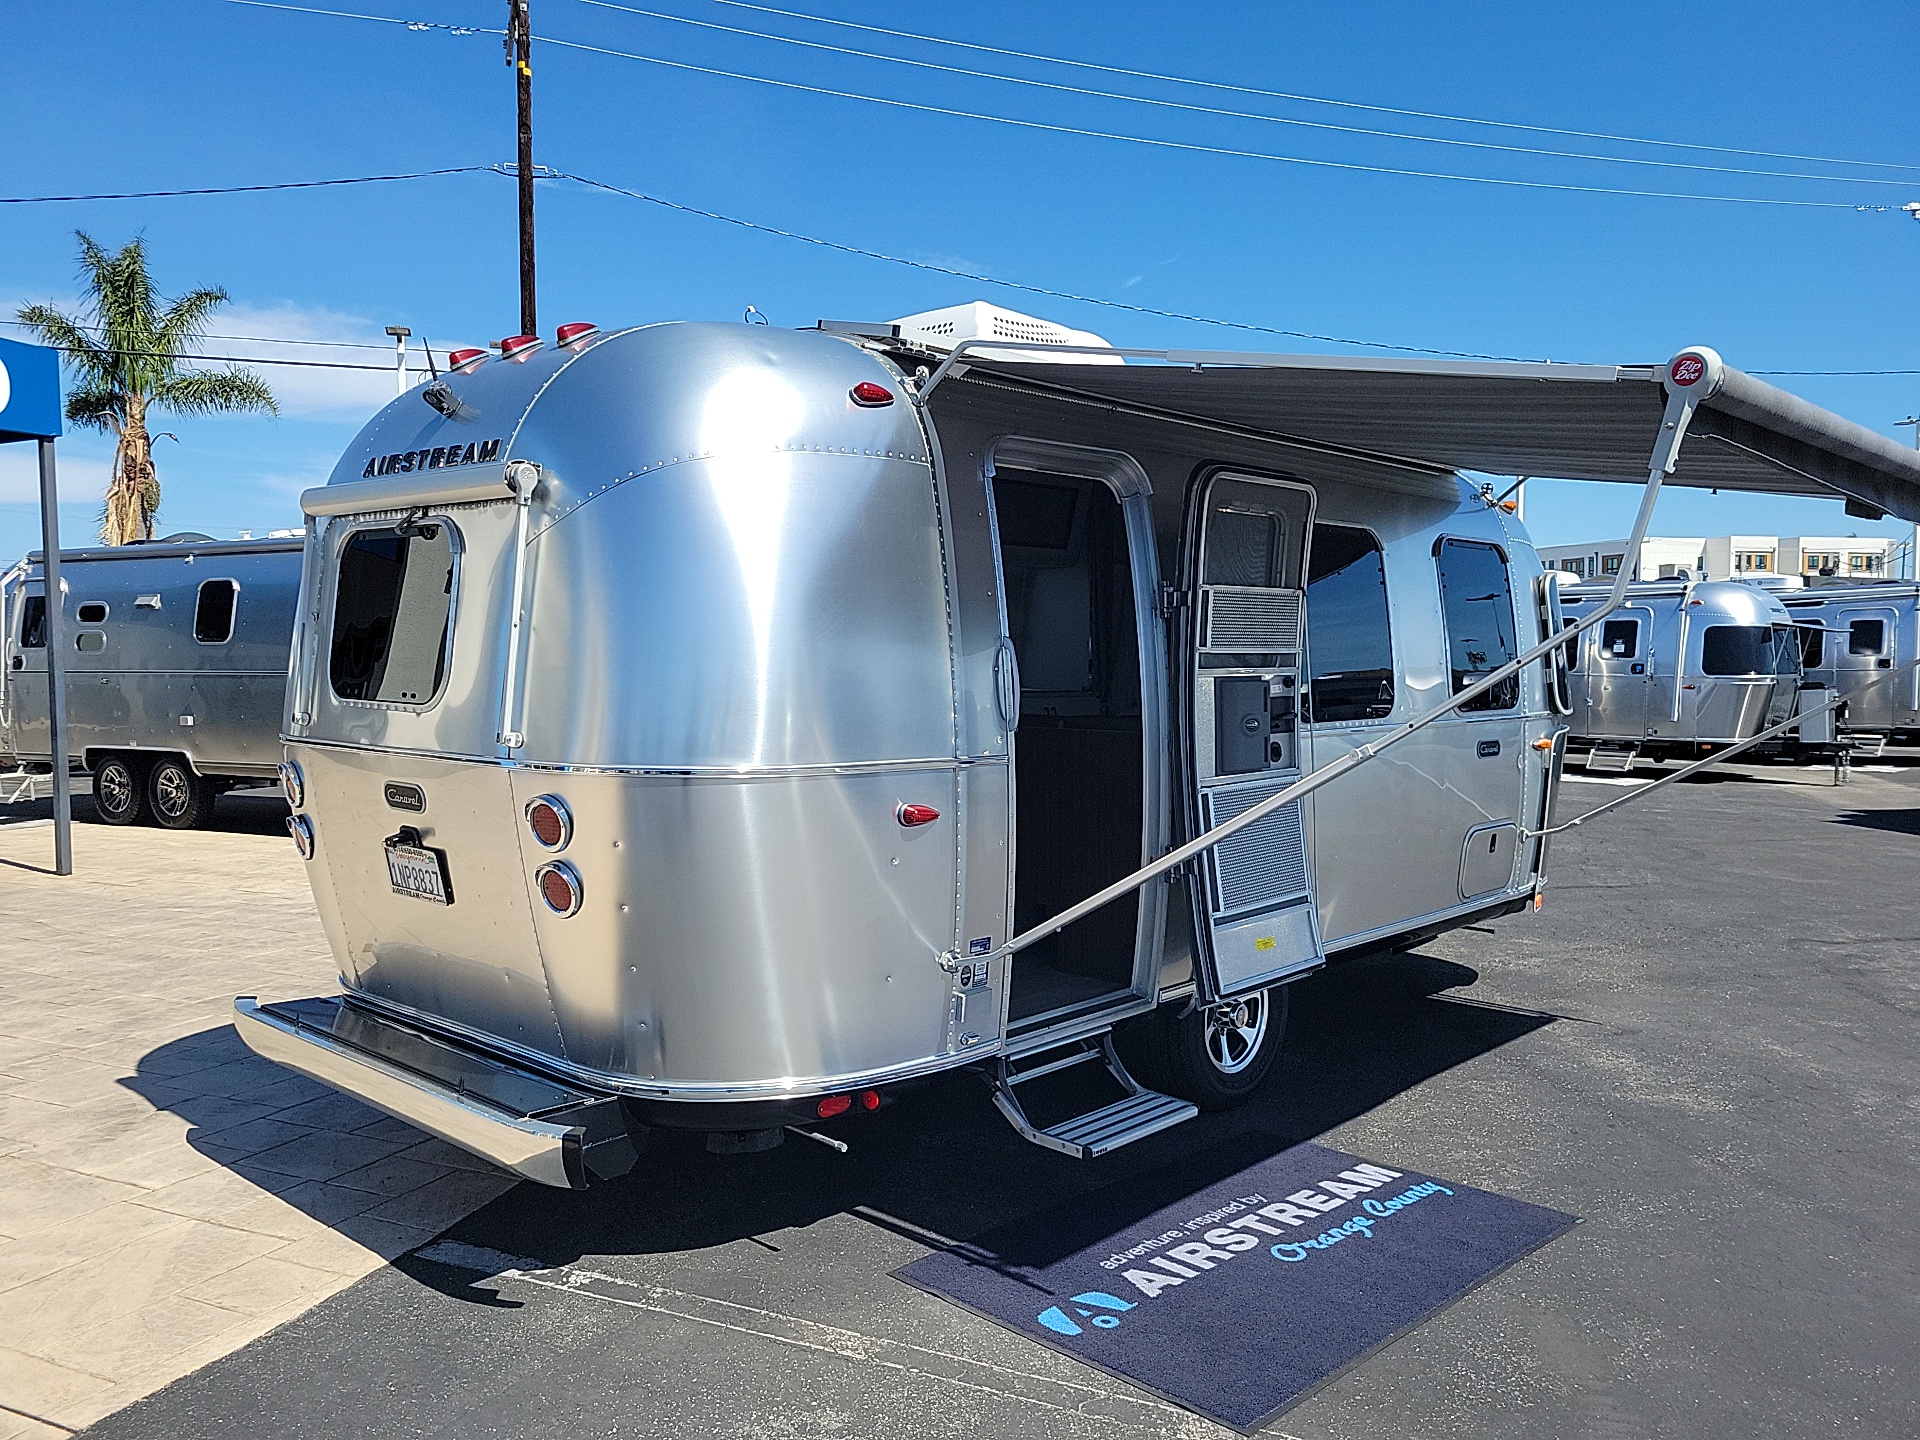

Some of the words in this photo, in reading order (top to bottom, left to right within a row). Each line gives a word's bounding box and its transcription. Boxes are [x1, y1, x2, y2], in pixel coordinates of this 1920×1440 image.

[1674, 369, 1699, 380] Dee
[1679, 360, 1701, 372] Zip
[363, 438, 503, 478] AIRSTREAM
[387, 788, 421, 805] Caravel
[392, 862, 441, 896] 1NP8837
[1100, 1222, 1191, 1270] adventure,
[1183, 1200, 1247, 1232] inspired
[1237, 1193, 1269, 1209] by
[1121, 1163, 1404, 1298] AIRSTREAM
[1270, 1216, 1375, 1262] Orange
[1362, 1180, 1454, 1217] County
